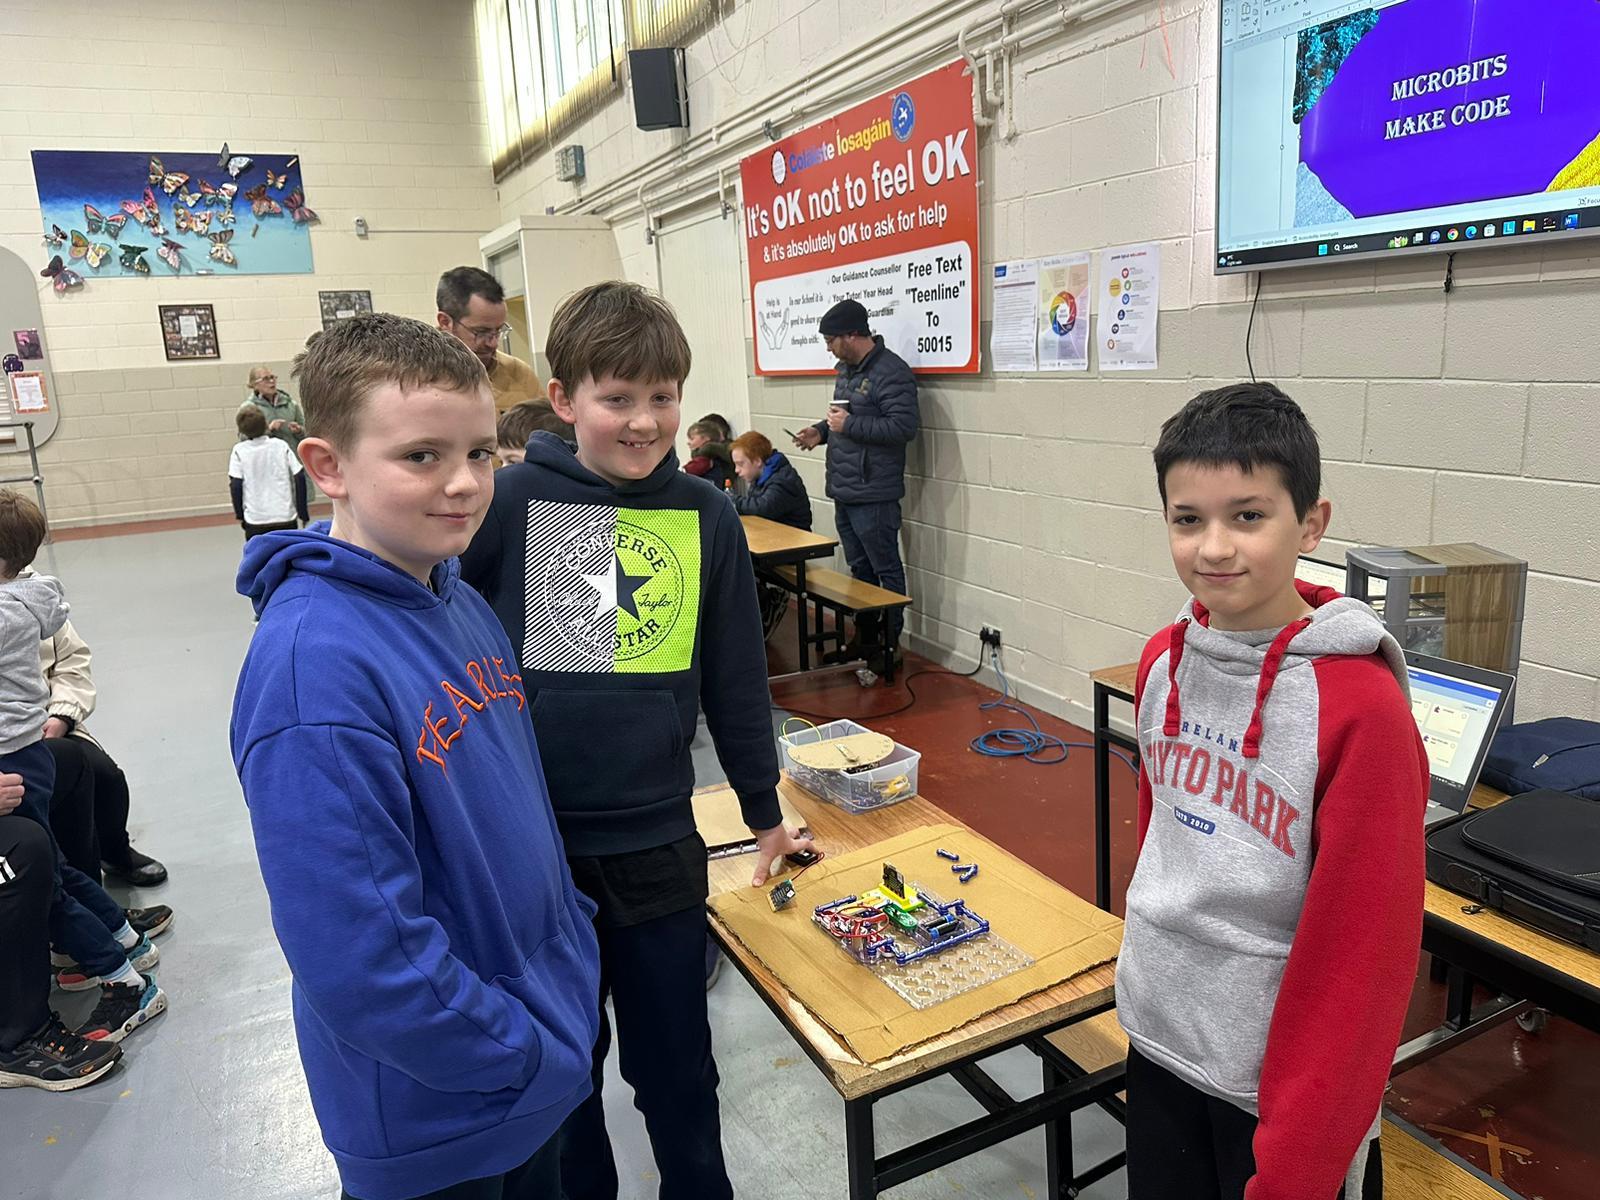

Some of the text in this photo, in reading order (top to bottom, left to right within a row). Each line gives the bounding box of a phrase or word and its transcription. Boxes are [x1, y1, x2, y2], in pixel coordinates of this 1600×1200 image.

[1391, 54, 1508, 101] MICROBITS
[1384, 95, 1511, 140] MAKE CODE
[746, 128, 970, 238] It's OK not to feel OK
[763, 200, 947, 263] & it's absolutely OK to ask for help
[832, 274, 841, 284] Our
[842, 270, 869, 282] Guidance
[908, 254, 962, 279] Free Text
[863, 289, 877, 298] Year
[877, 285, 893, 296] Head
[905, 280, 966, 304] "Teenline"
[925, 311, 940, 328] To
[917, 336, 953, 353] 50015
[565, 532, 668, 573] CONVERSE
[638, 593, 673, 612] Taylor
[568, 616, 661, 649] ALL STAR
[1209, 755, 1301, 860] PARK
[1190, 818, 1210, 831] 2010
